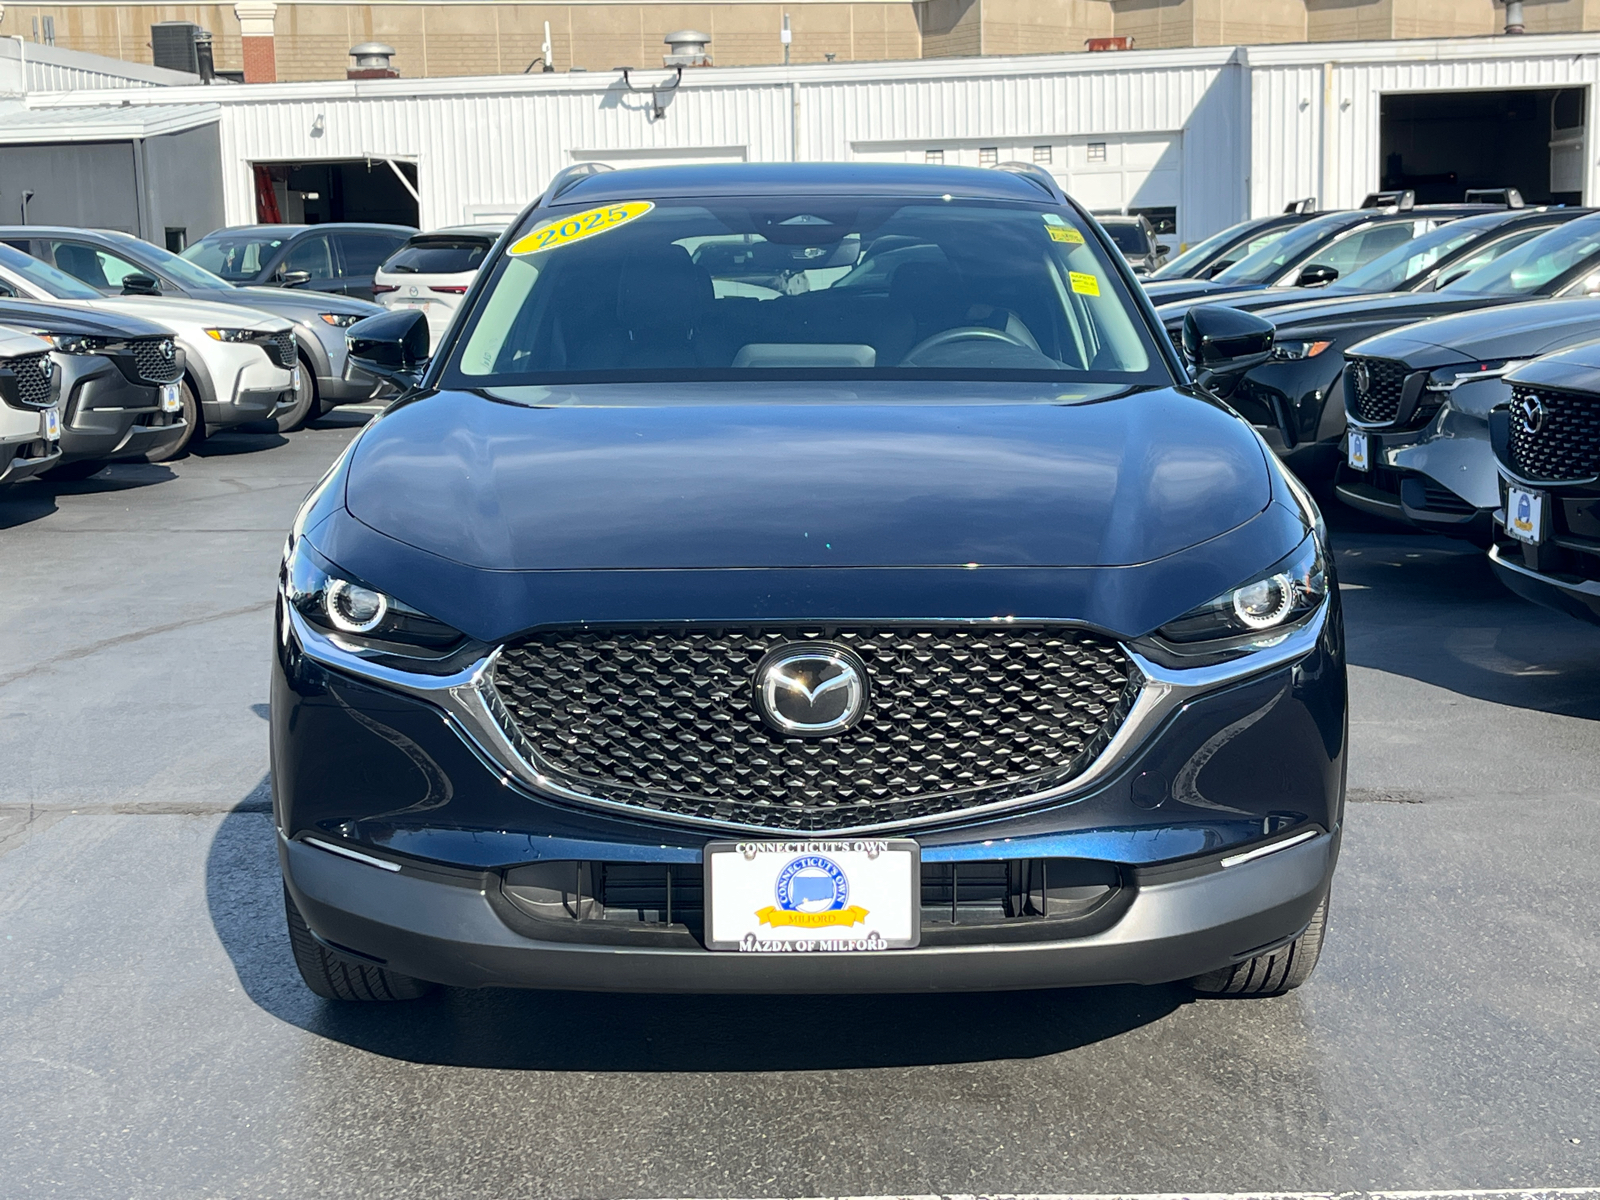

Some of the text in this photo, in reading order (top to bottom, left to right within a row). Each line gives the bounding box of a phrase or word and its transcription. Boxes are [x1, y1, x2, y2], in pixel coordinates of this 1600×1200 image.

[536, 205, 628, 248] 2025
[735, 841, 888, 853] CONNECTICUT'S OWN
[778, 857, 846, 903] CONNECTICUT'S OWN
[788, 914, 837, 924] MILFORD
[739, 938, 888, 952] MAZDA OF MILFORD
